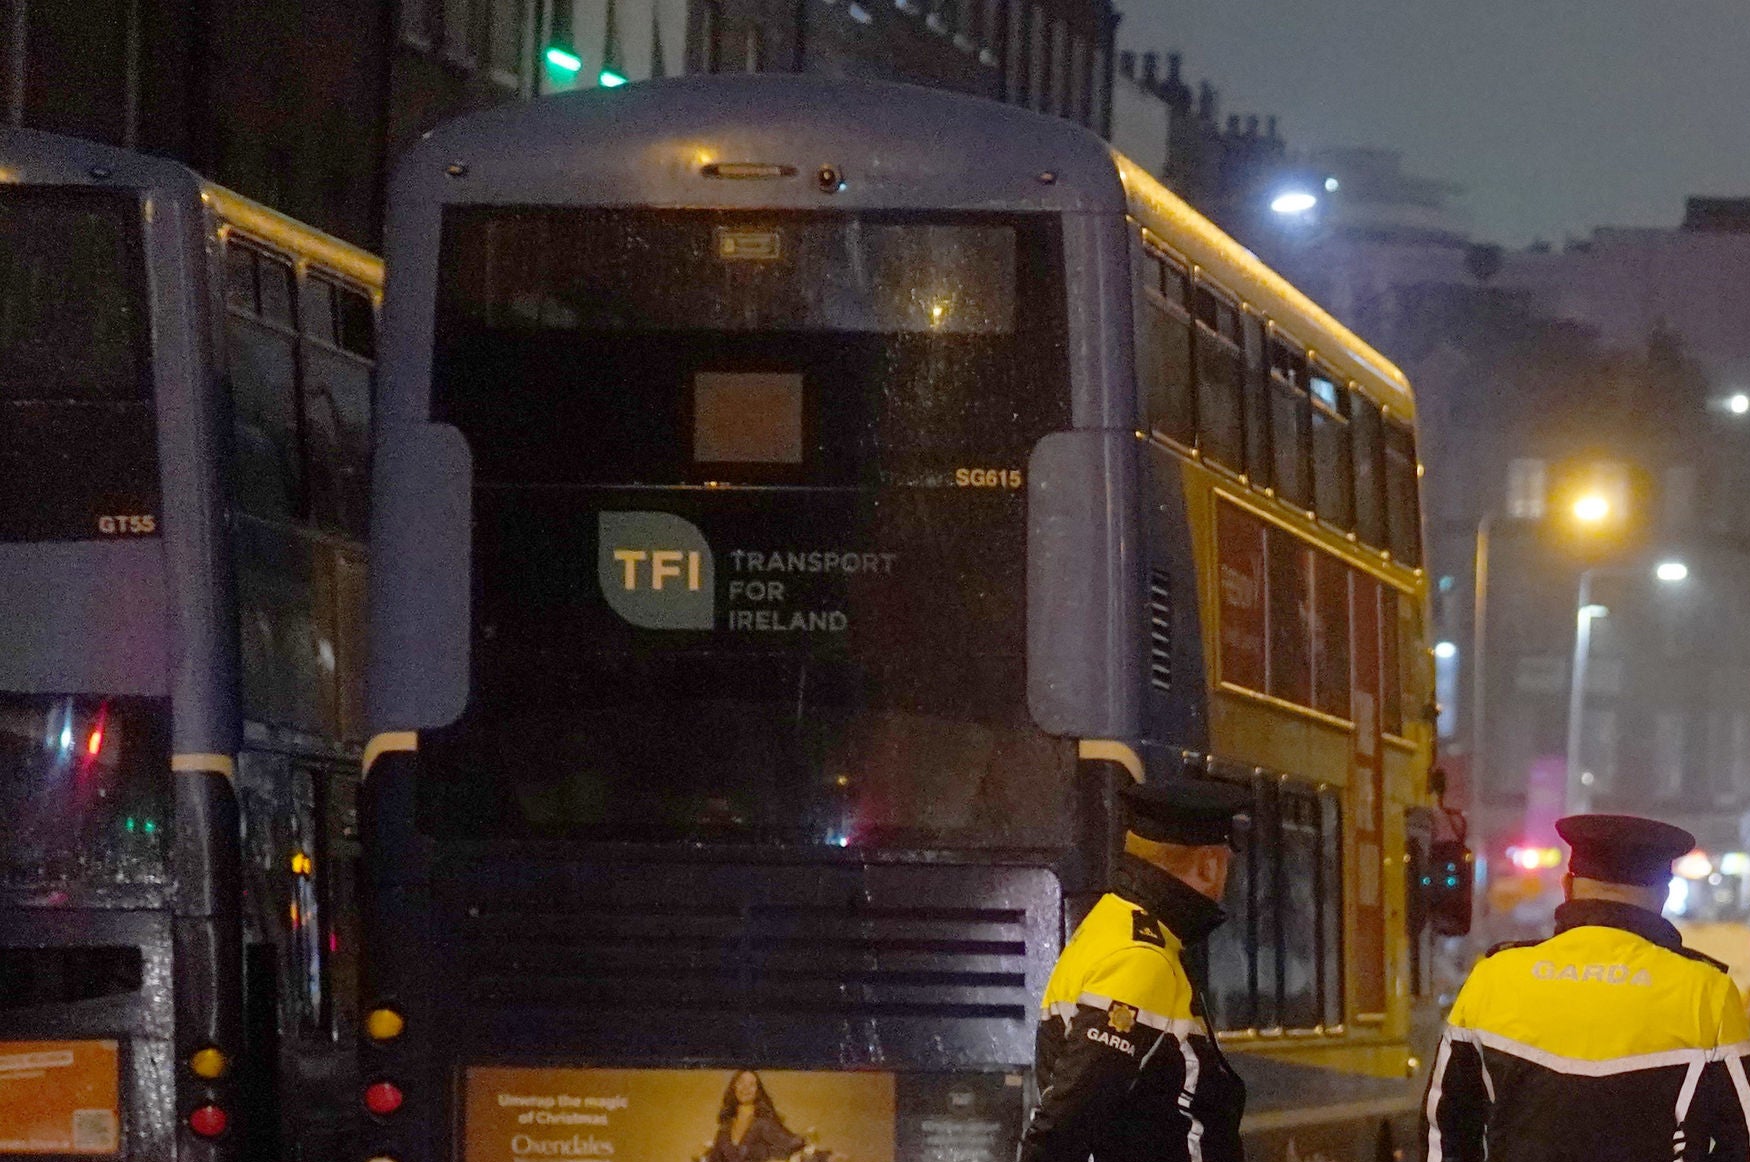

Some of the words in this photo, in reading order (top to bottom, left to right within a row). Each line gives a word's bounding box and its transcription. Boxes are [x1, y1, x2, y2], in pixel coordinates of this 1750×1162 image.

[955, 467, 1021, 488] SG615
[99, 515, 156, 533] GT55
[613, 550, 699, 590] TFI
[729, 550, 896, 574] TRANSPORT
[728, 581, 786, 601] FOR
[728, 610, 849, 632] IRELAND
[1531, 960, 1653, 987] GARDA
[1086, 1027, 1136, 1057] GARDA
[518, 1111, 535, 1124] of
[536, 1112, 608, 1126] Christmas
[511, 1134, 615, 1156] Oxendales
